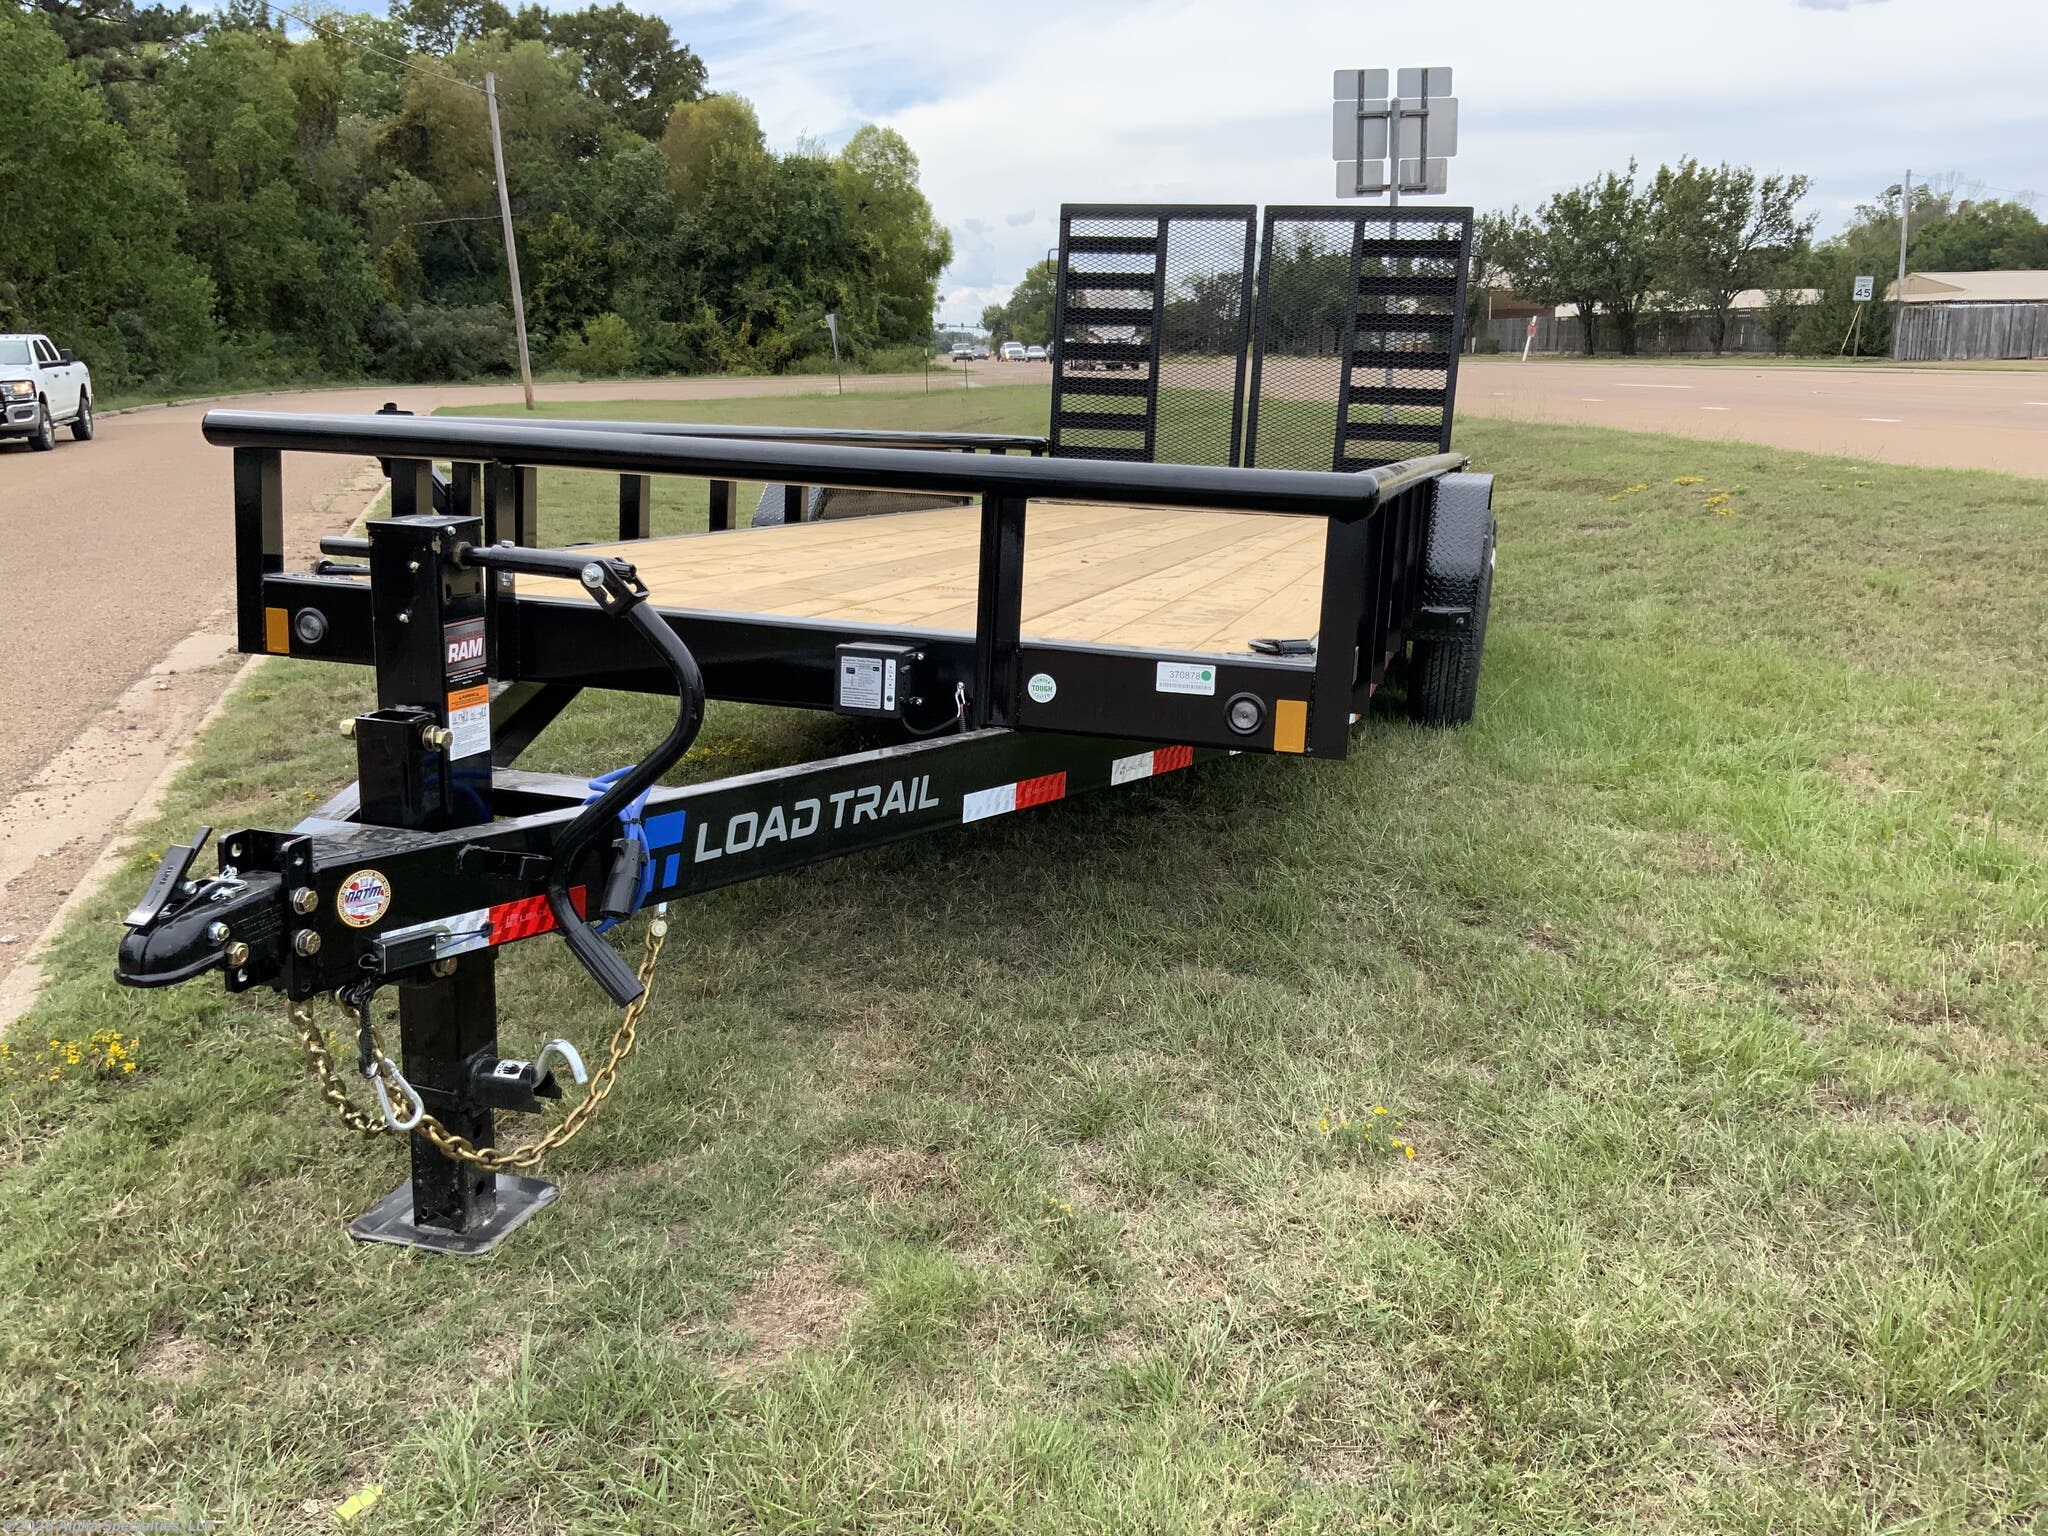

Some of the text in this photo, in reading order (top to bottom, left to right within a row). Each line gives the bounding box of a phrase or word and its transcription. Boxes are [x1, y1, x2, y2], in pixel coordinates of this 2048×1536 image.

[1856, 289, 1871, 297] 45
[448, 638, 483, 663] RAM
[1169, 671, 1200, 680] 370878
[694, 775, 939, 863] LOAD TRAIL
